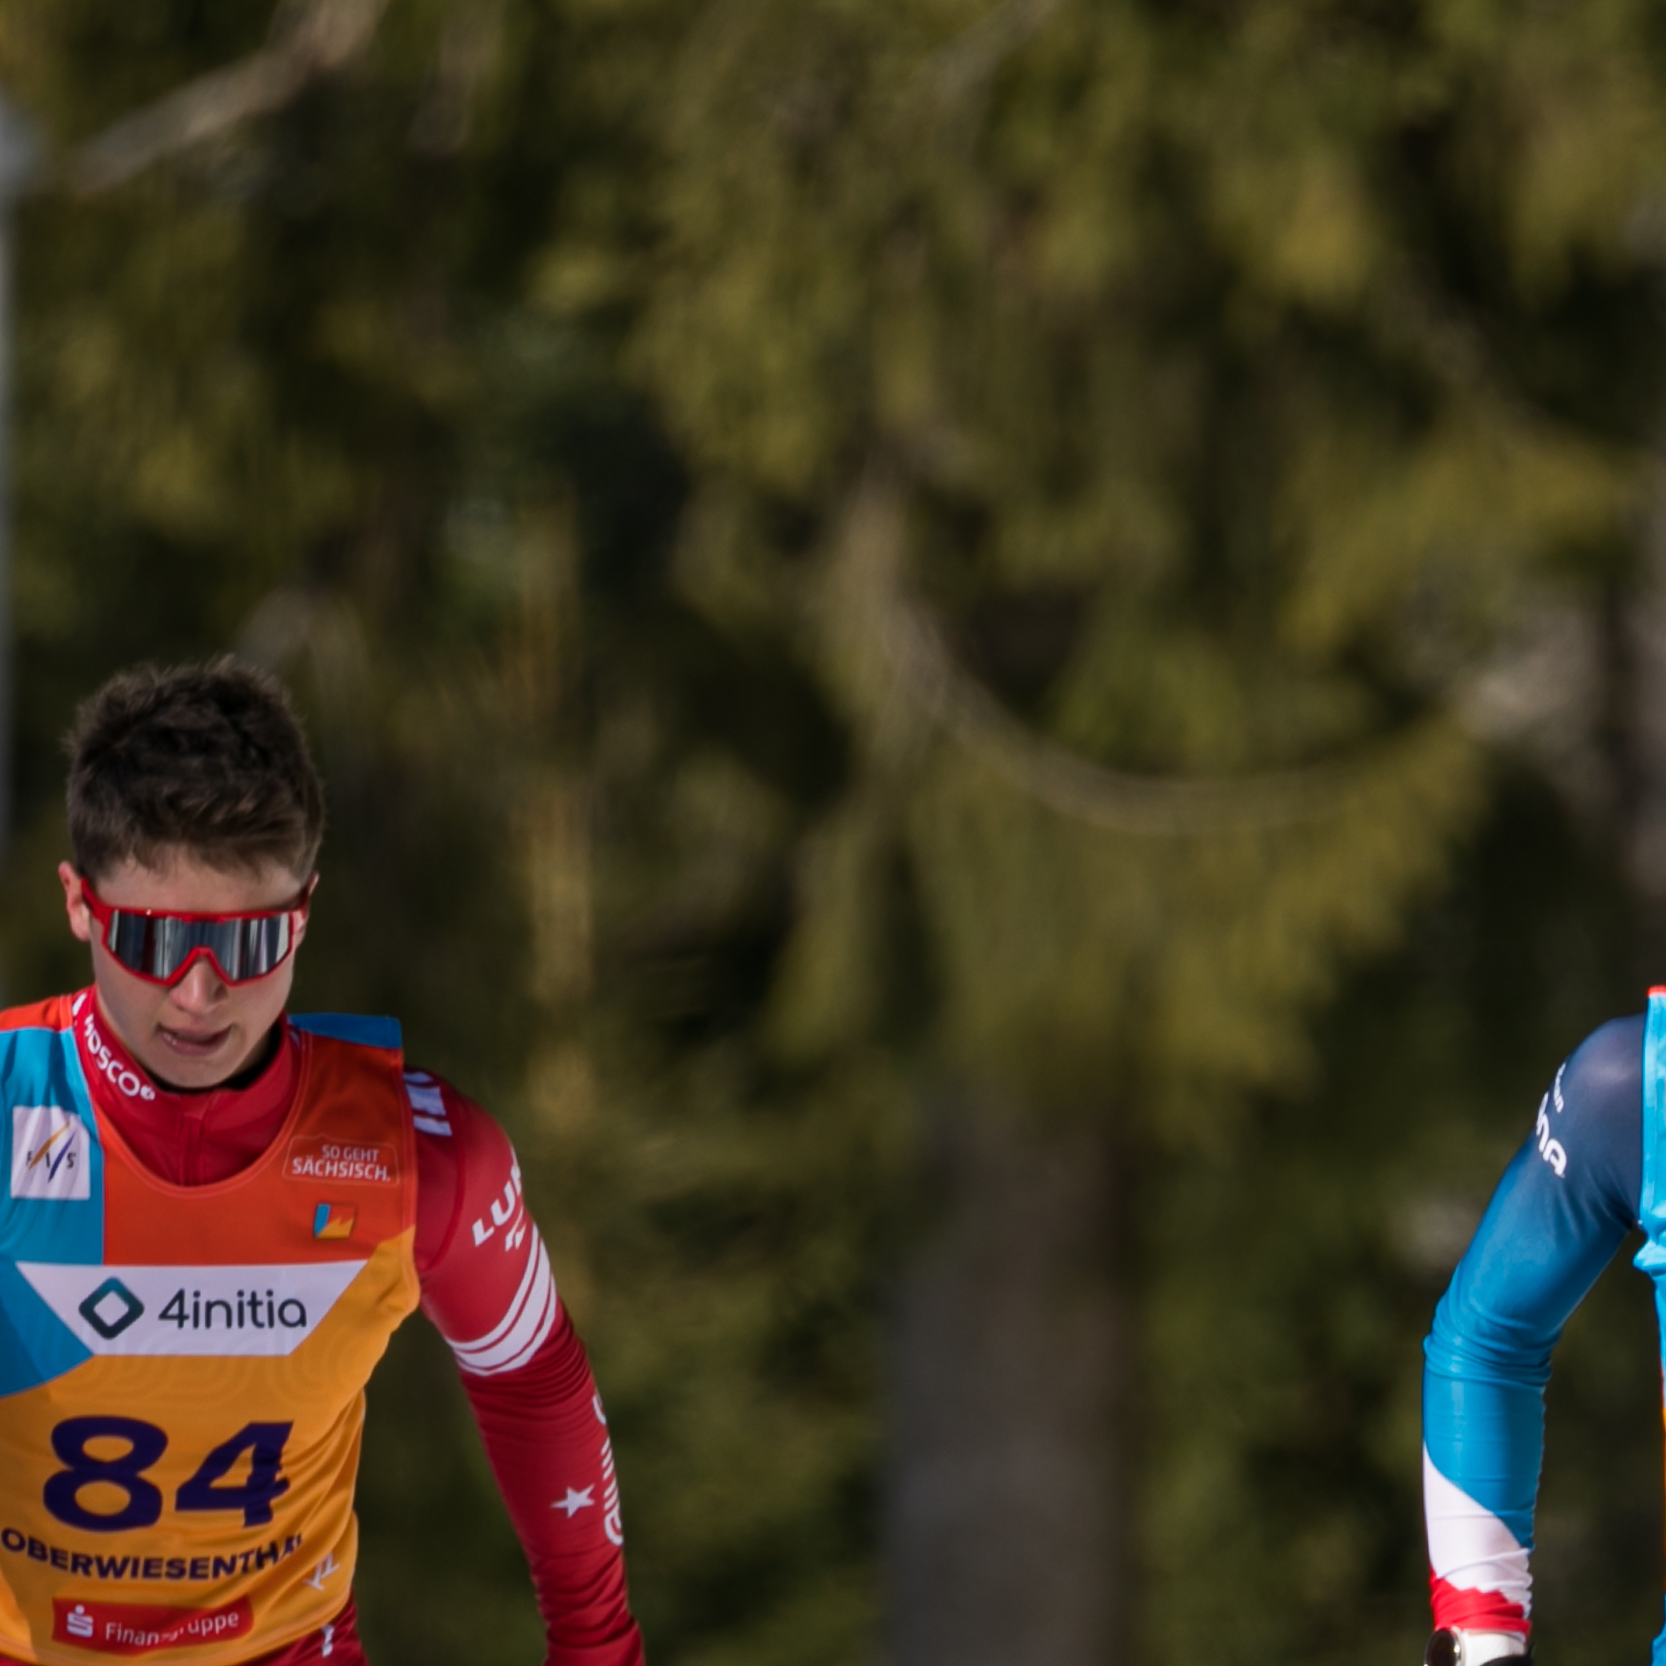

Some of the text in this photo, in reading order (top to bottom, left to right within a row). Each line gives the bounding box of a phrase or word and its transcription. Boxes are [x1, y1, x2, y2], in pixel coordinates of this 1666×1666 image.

[321, 1144, 380, 1162] SO GEHT
[157, 1287, 308, 1330] 4initia
[42, 1414, 295, 1534] 84
